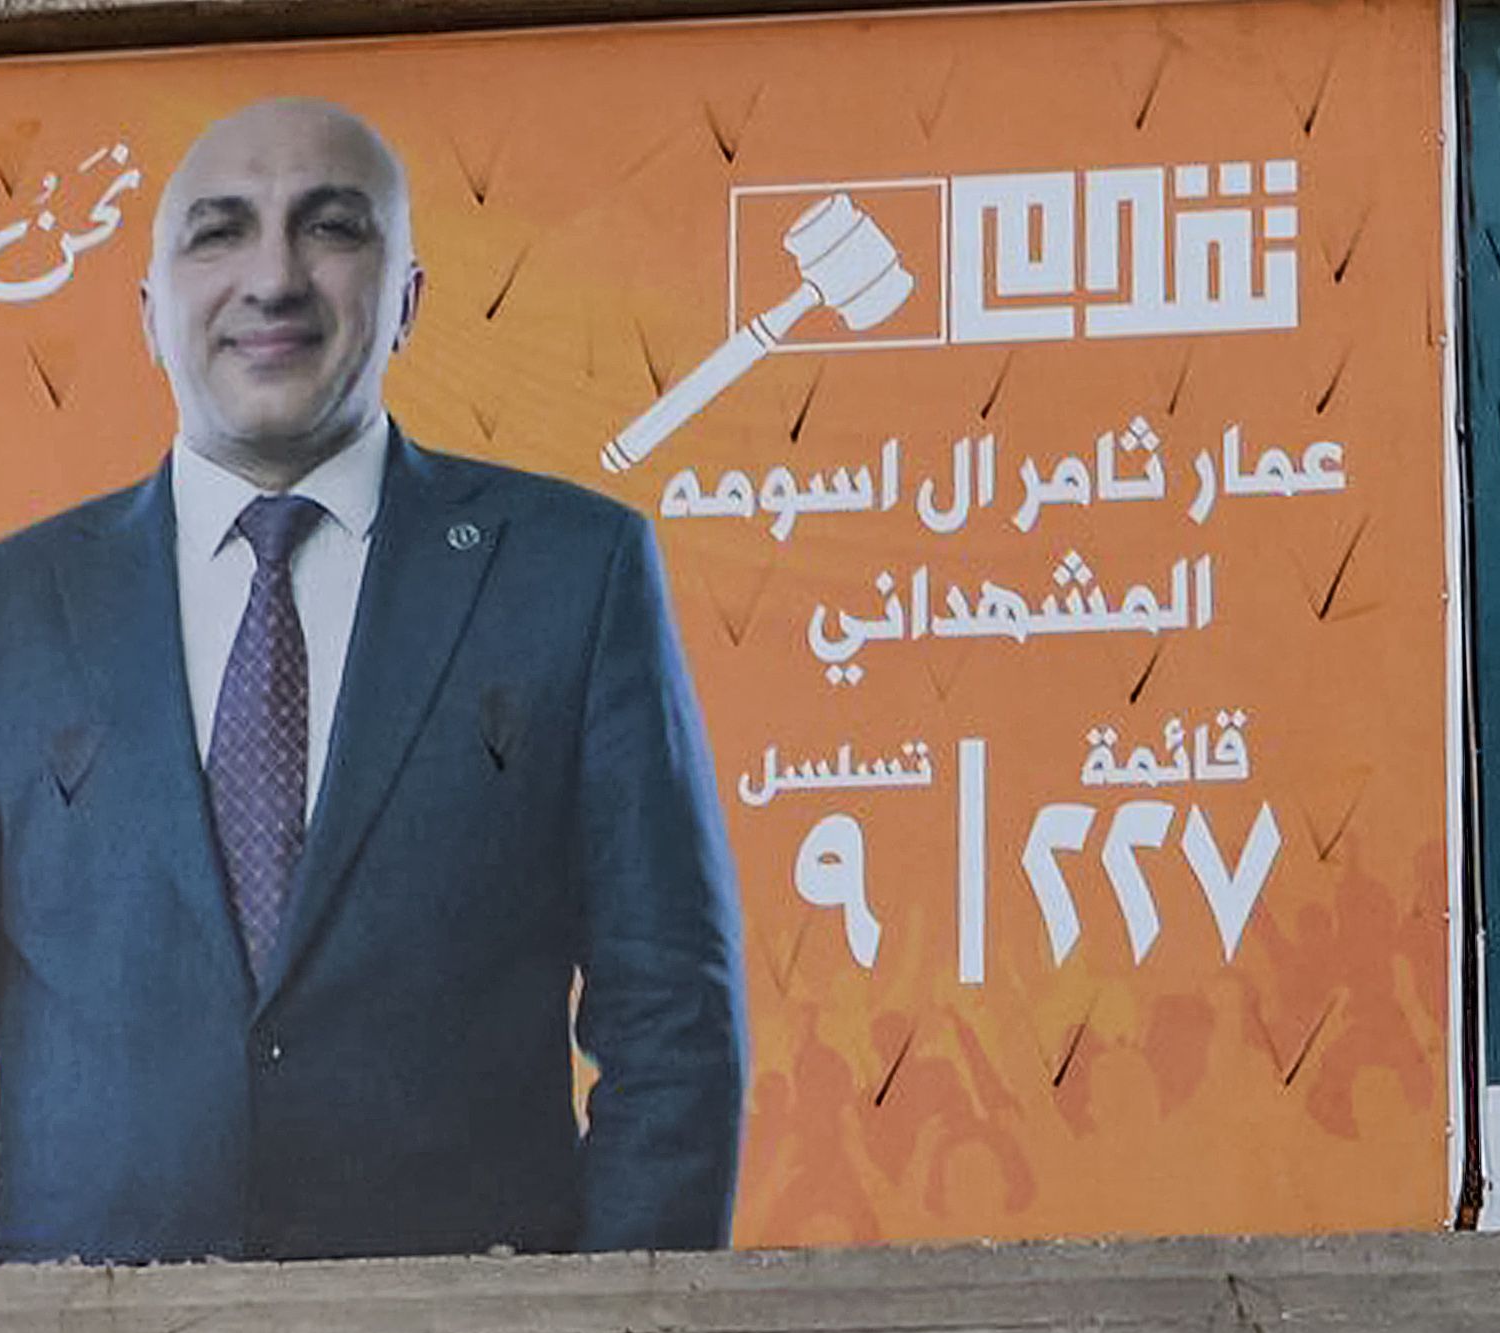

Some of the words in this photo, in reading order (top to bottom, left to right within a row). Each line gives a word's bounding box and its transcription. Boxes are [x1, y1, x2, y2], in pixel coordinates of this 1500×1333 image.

[951, 160, 1297, 344] تقدم
[659, 439, 899, 541] اسومه
[916, 434, 996, 531] ال
[1012, 416, 1166, 531] ثامر
[1188, 425, 1347, 523] عمار
[809, 550, 1214, 685] المشهداني
[739, 741, 932, 806] تسلسل
[1081, 709, 1250, 786] قائمة
[794, 814, 882, 970] ٩
[1022, 800, 1282, 968] ٢٢٧
